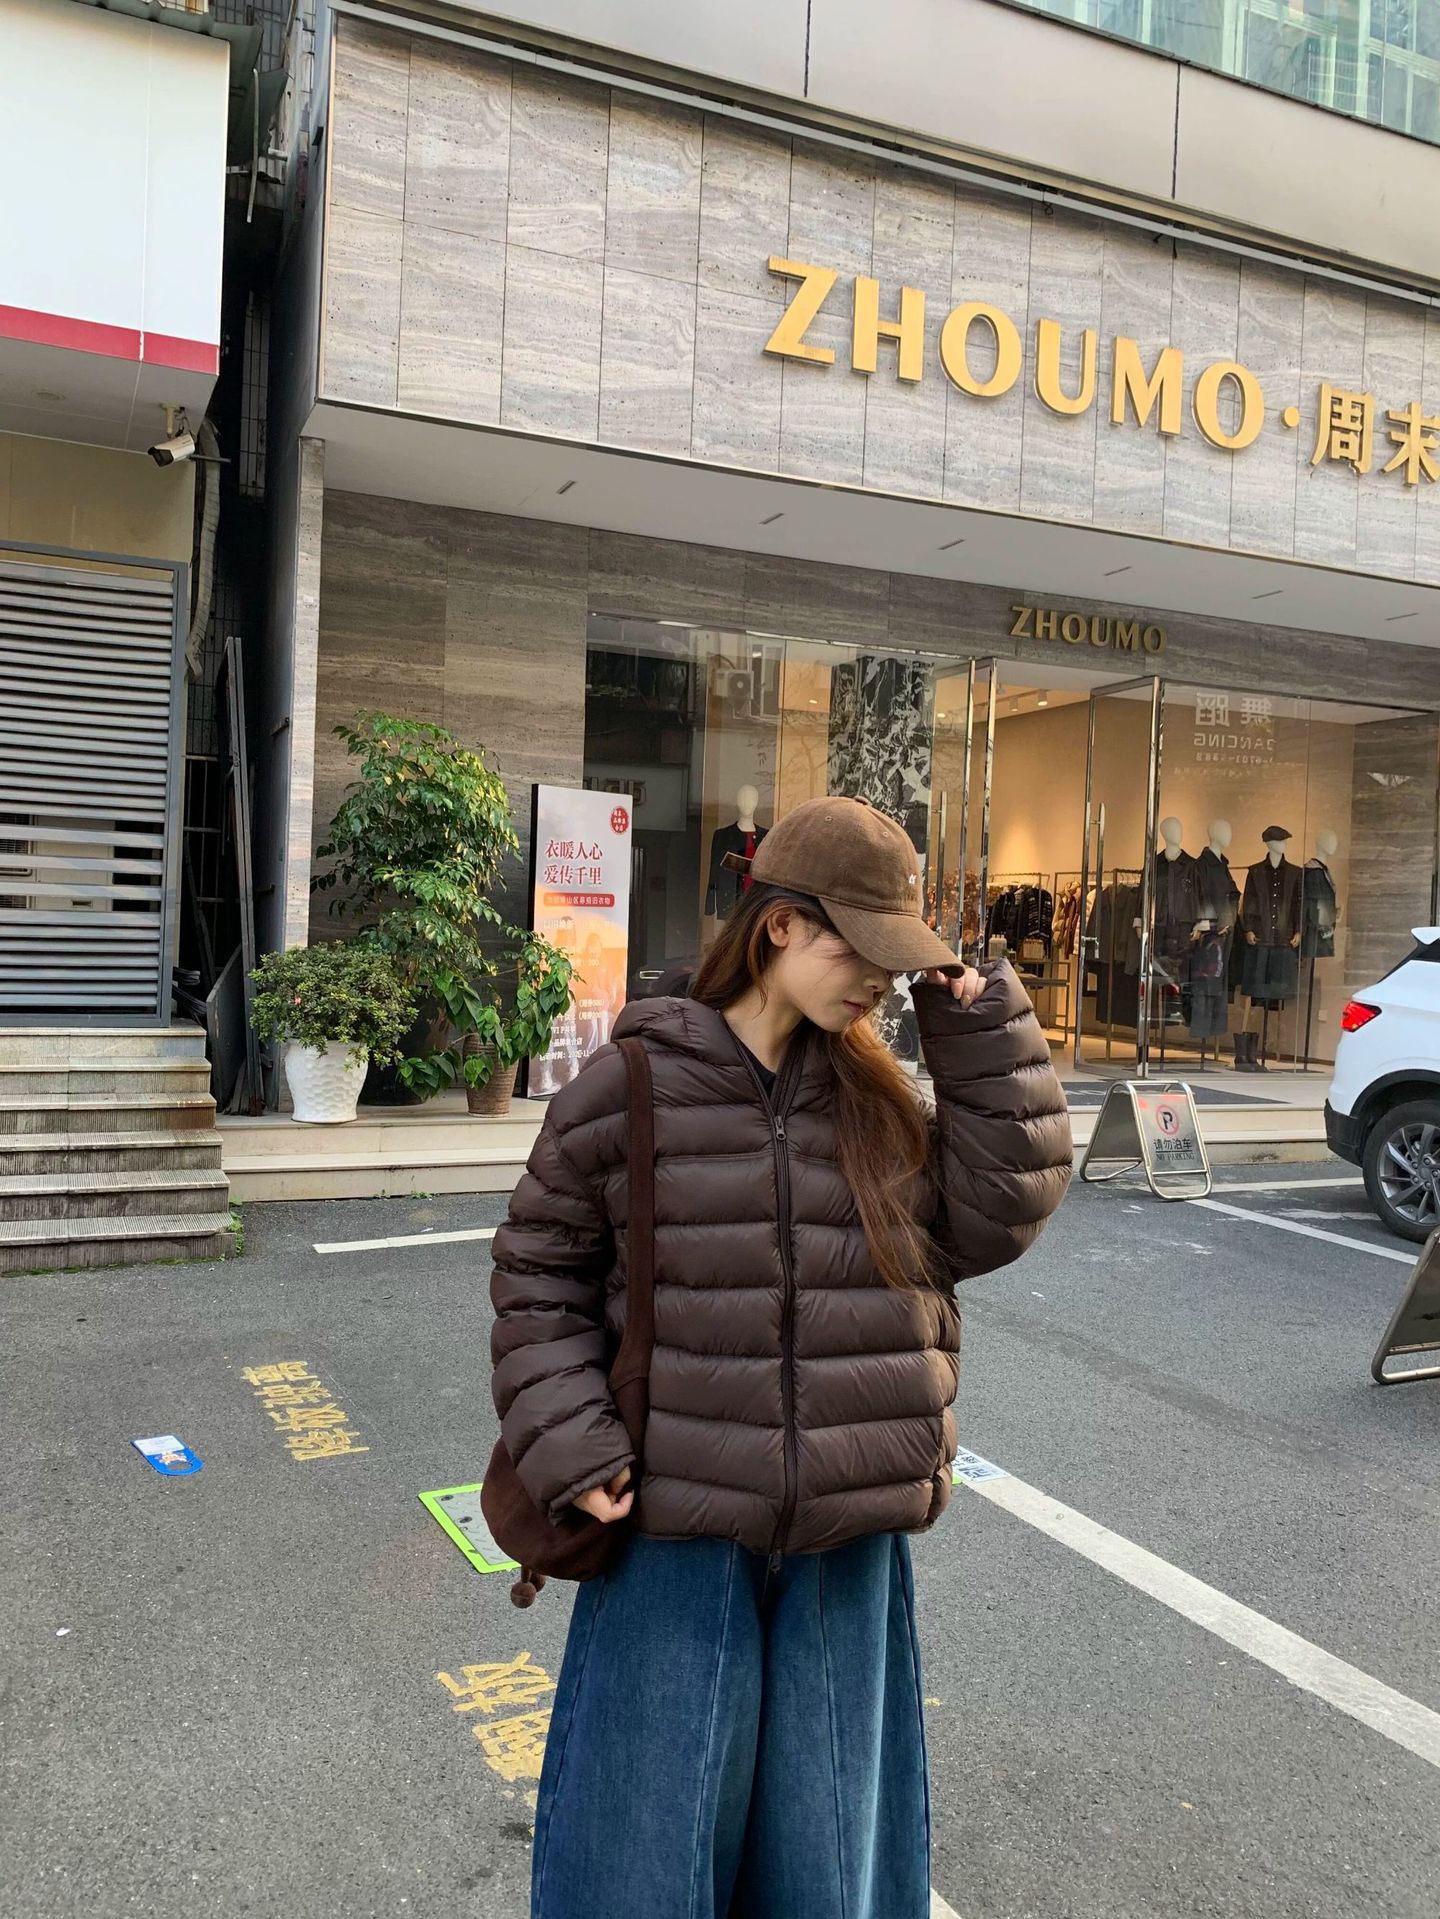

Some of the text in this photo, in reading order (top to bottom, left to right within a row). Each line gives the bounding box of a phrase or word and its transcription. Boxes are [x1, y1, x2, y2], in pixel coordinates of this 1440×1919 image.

[763, 255, 1266, 452] ZHOUMO
[1310, 382, 1440, 487] 周末
[1010, 605, 1169, 656] ZHOUMO
[544, 839, 603, 861] 衣暖人心
[544, 864, 603, 886] 爱传千里
[1153, 1138, 1193, 1151] 请勿泊车
[1156, 1153, 1195, 1161] NO PARKING
